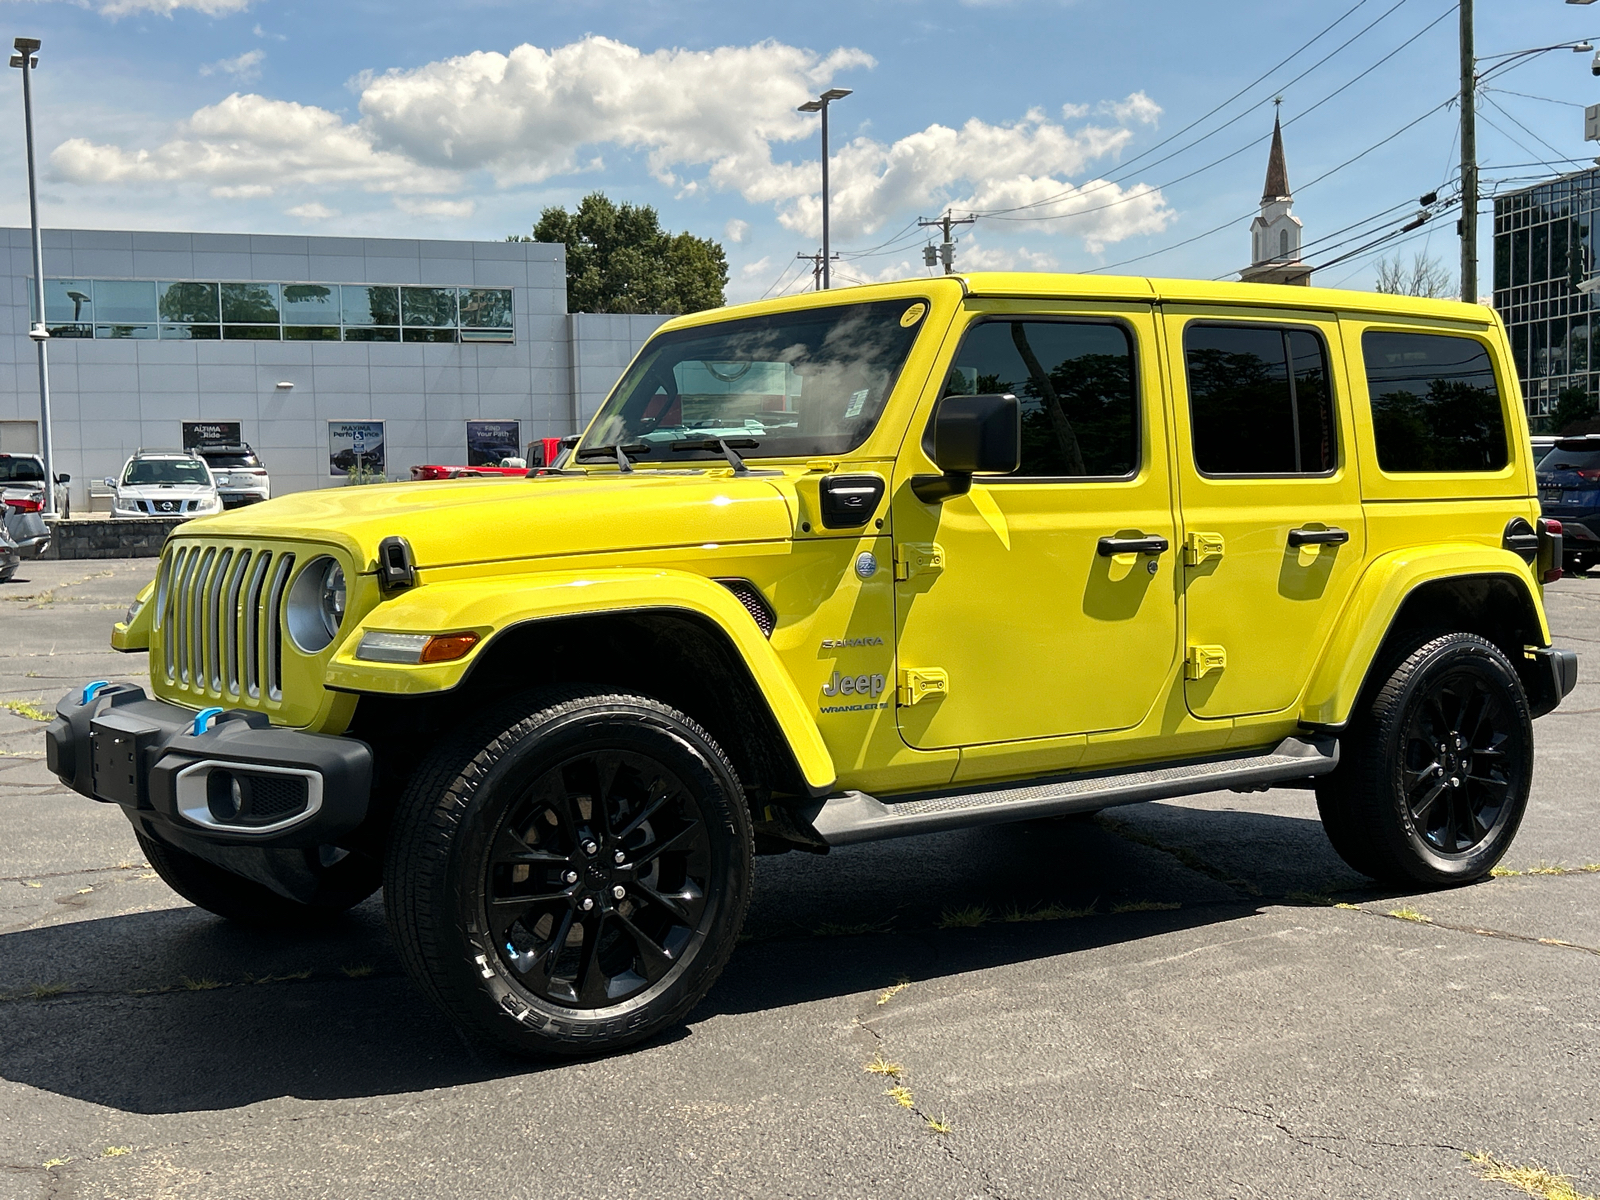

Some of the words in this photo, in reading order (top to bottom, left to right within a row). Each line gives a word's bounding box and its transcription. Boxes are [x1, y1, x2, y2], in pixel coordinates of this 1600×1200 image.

[822, 637, 884, 649] SAHARA
[822, 671, 886, 698] Jeep
[820, 703, 878, 714] WRANGLER
